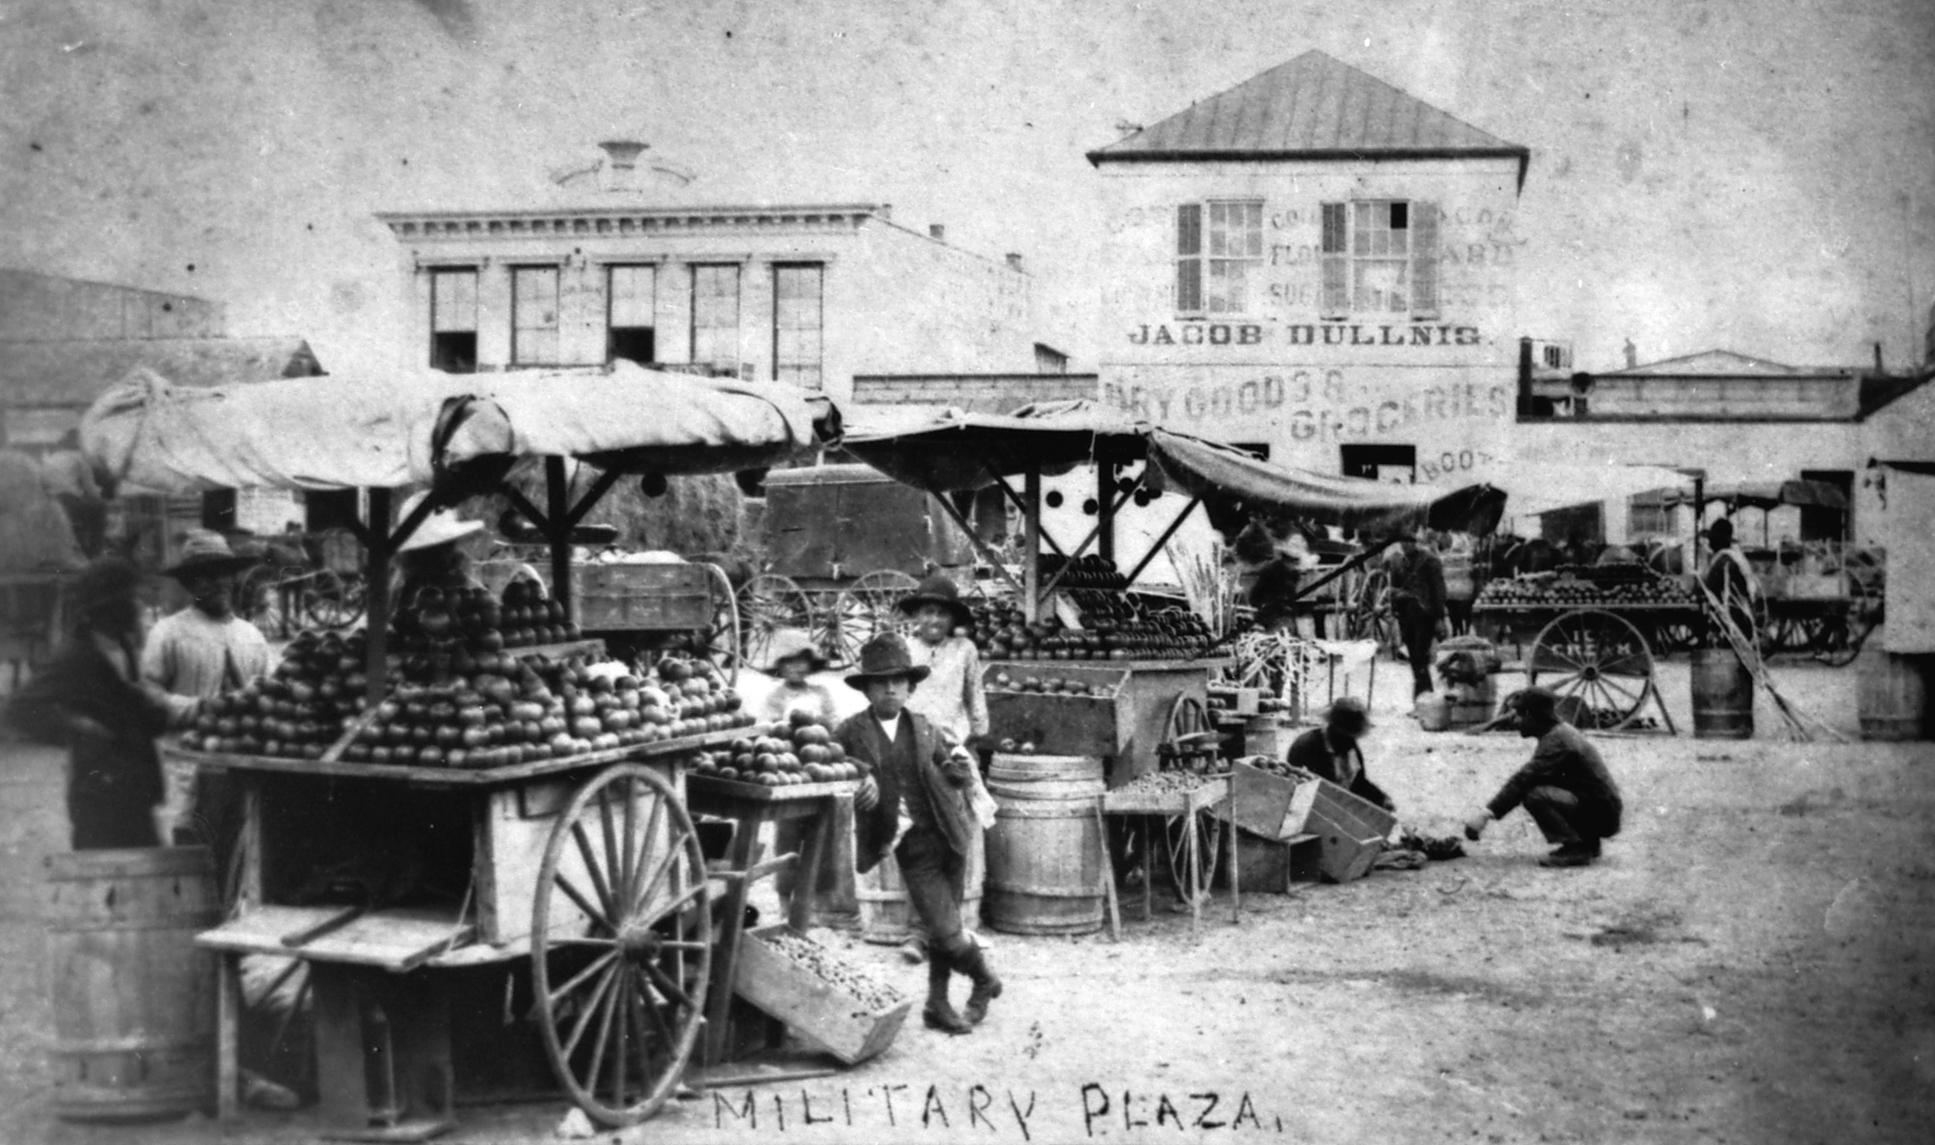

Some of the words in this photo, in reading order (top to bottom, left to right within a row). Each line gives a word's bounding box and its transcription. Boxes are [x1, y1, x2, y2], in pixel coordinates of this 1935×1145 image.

[1127, 323, 1263, 346] JACOB
[1184, 369, 1311, 421] GOODS
[1290, 382, 1507, 442] GROCERIES
[1551, 642, 1631, 657] CREAM
